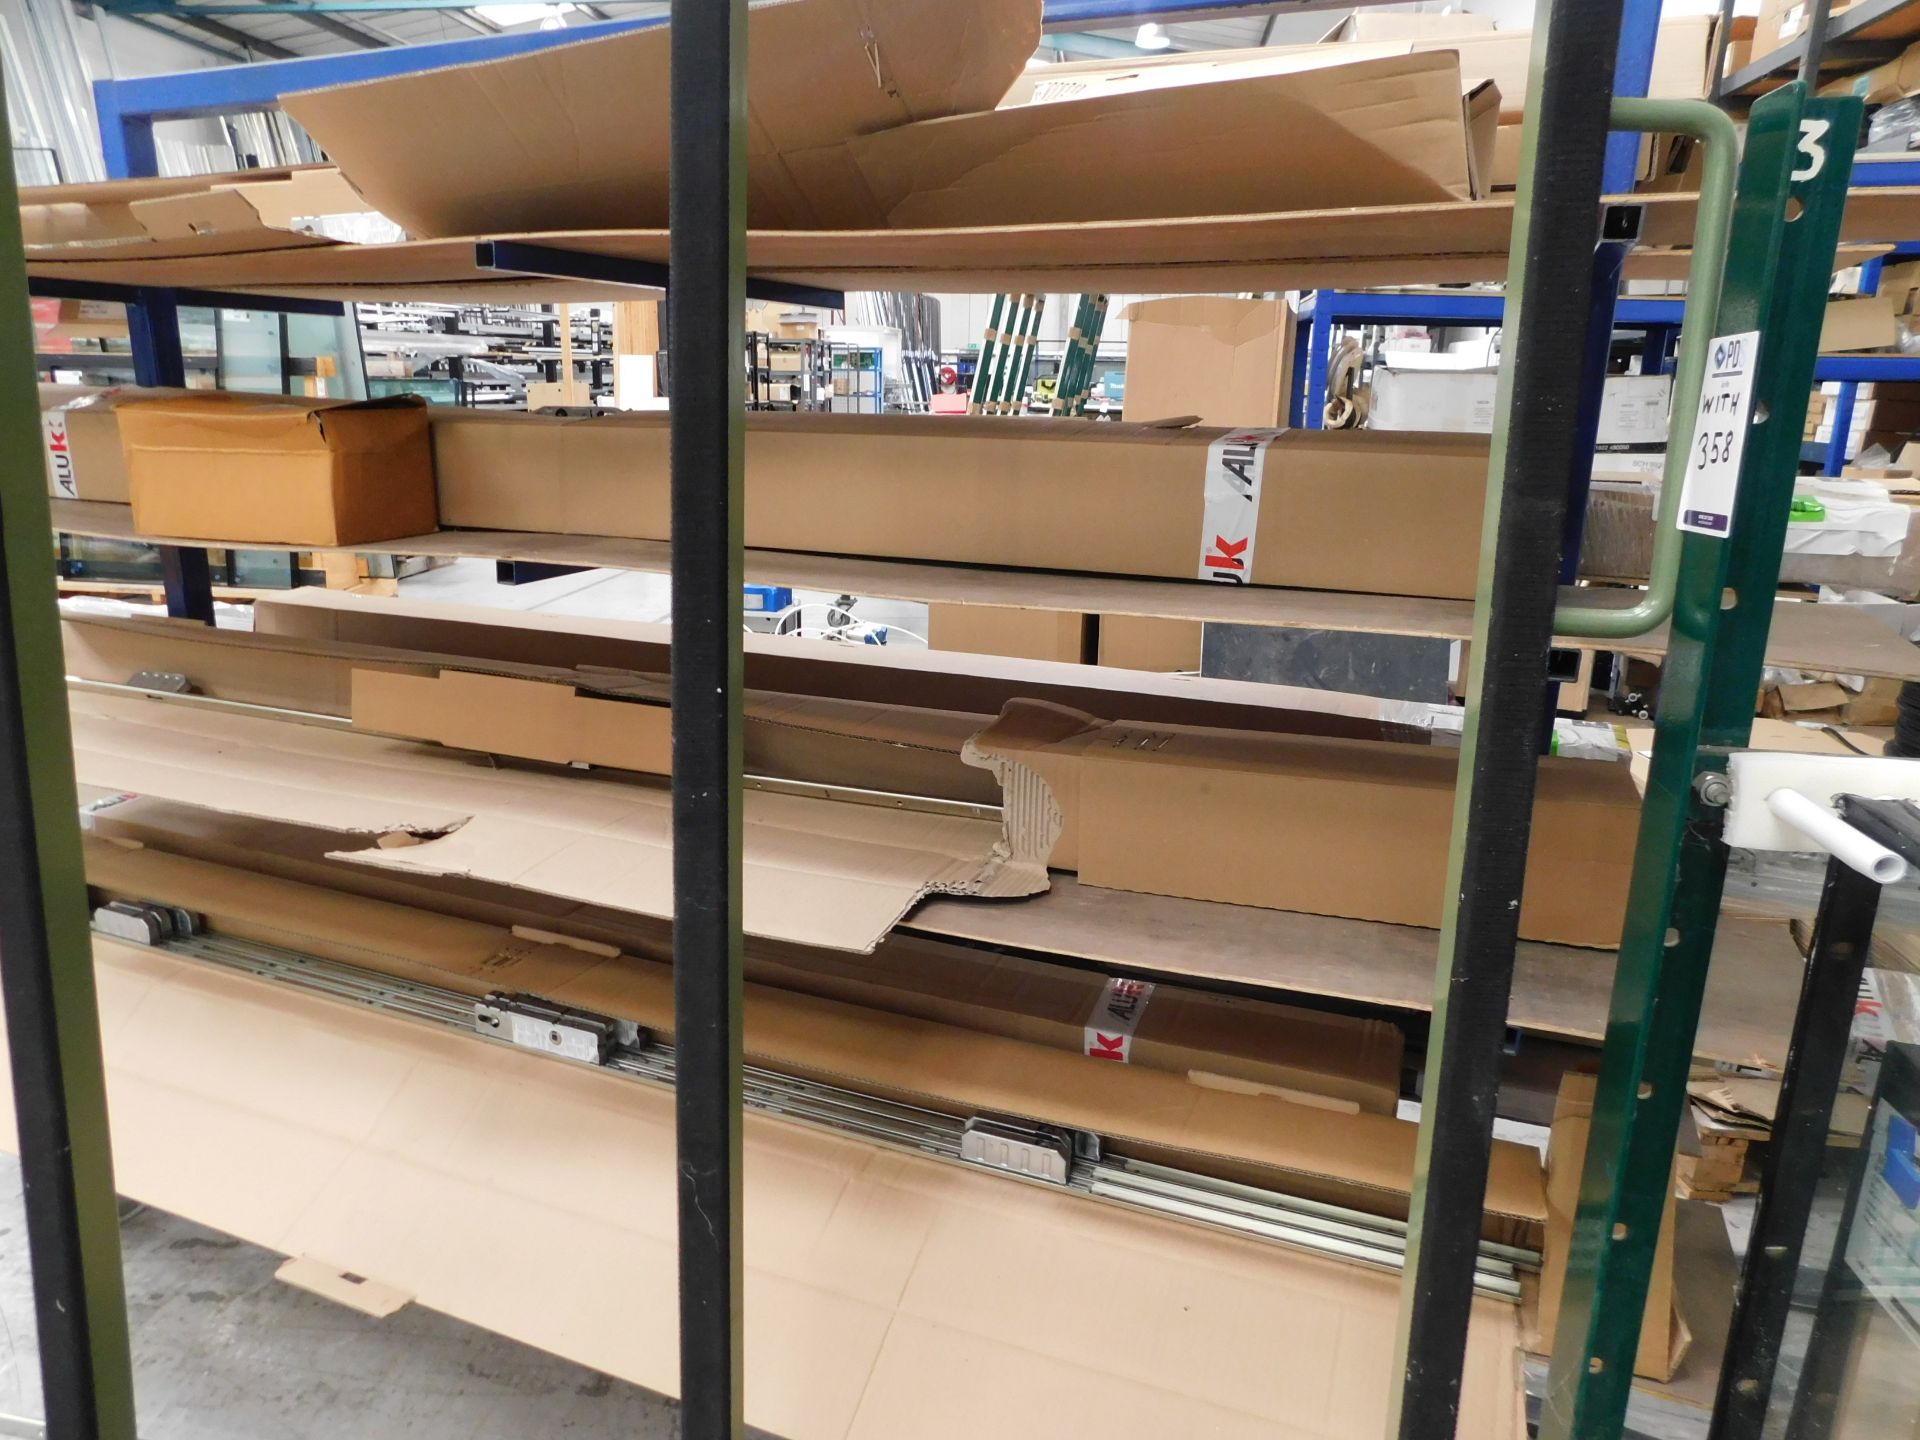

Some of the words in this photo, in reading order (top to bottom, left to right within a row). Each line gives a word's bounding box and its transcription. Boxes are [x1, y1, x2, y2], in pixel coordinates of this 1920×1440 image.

[1790, 119, 1830, 182] 3
[1702, 391, 1740, 417] WITH
[1697, 429, 1734, 470] 358
